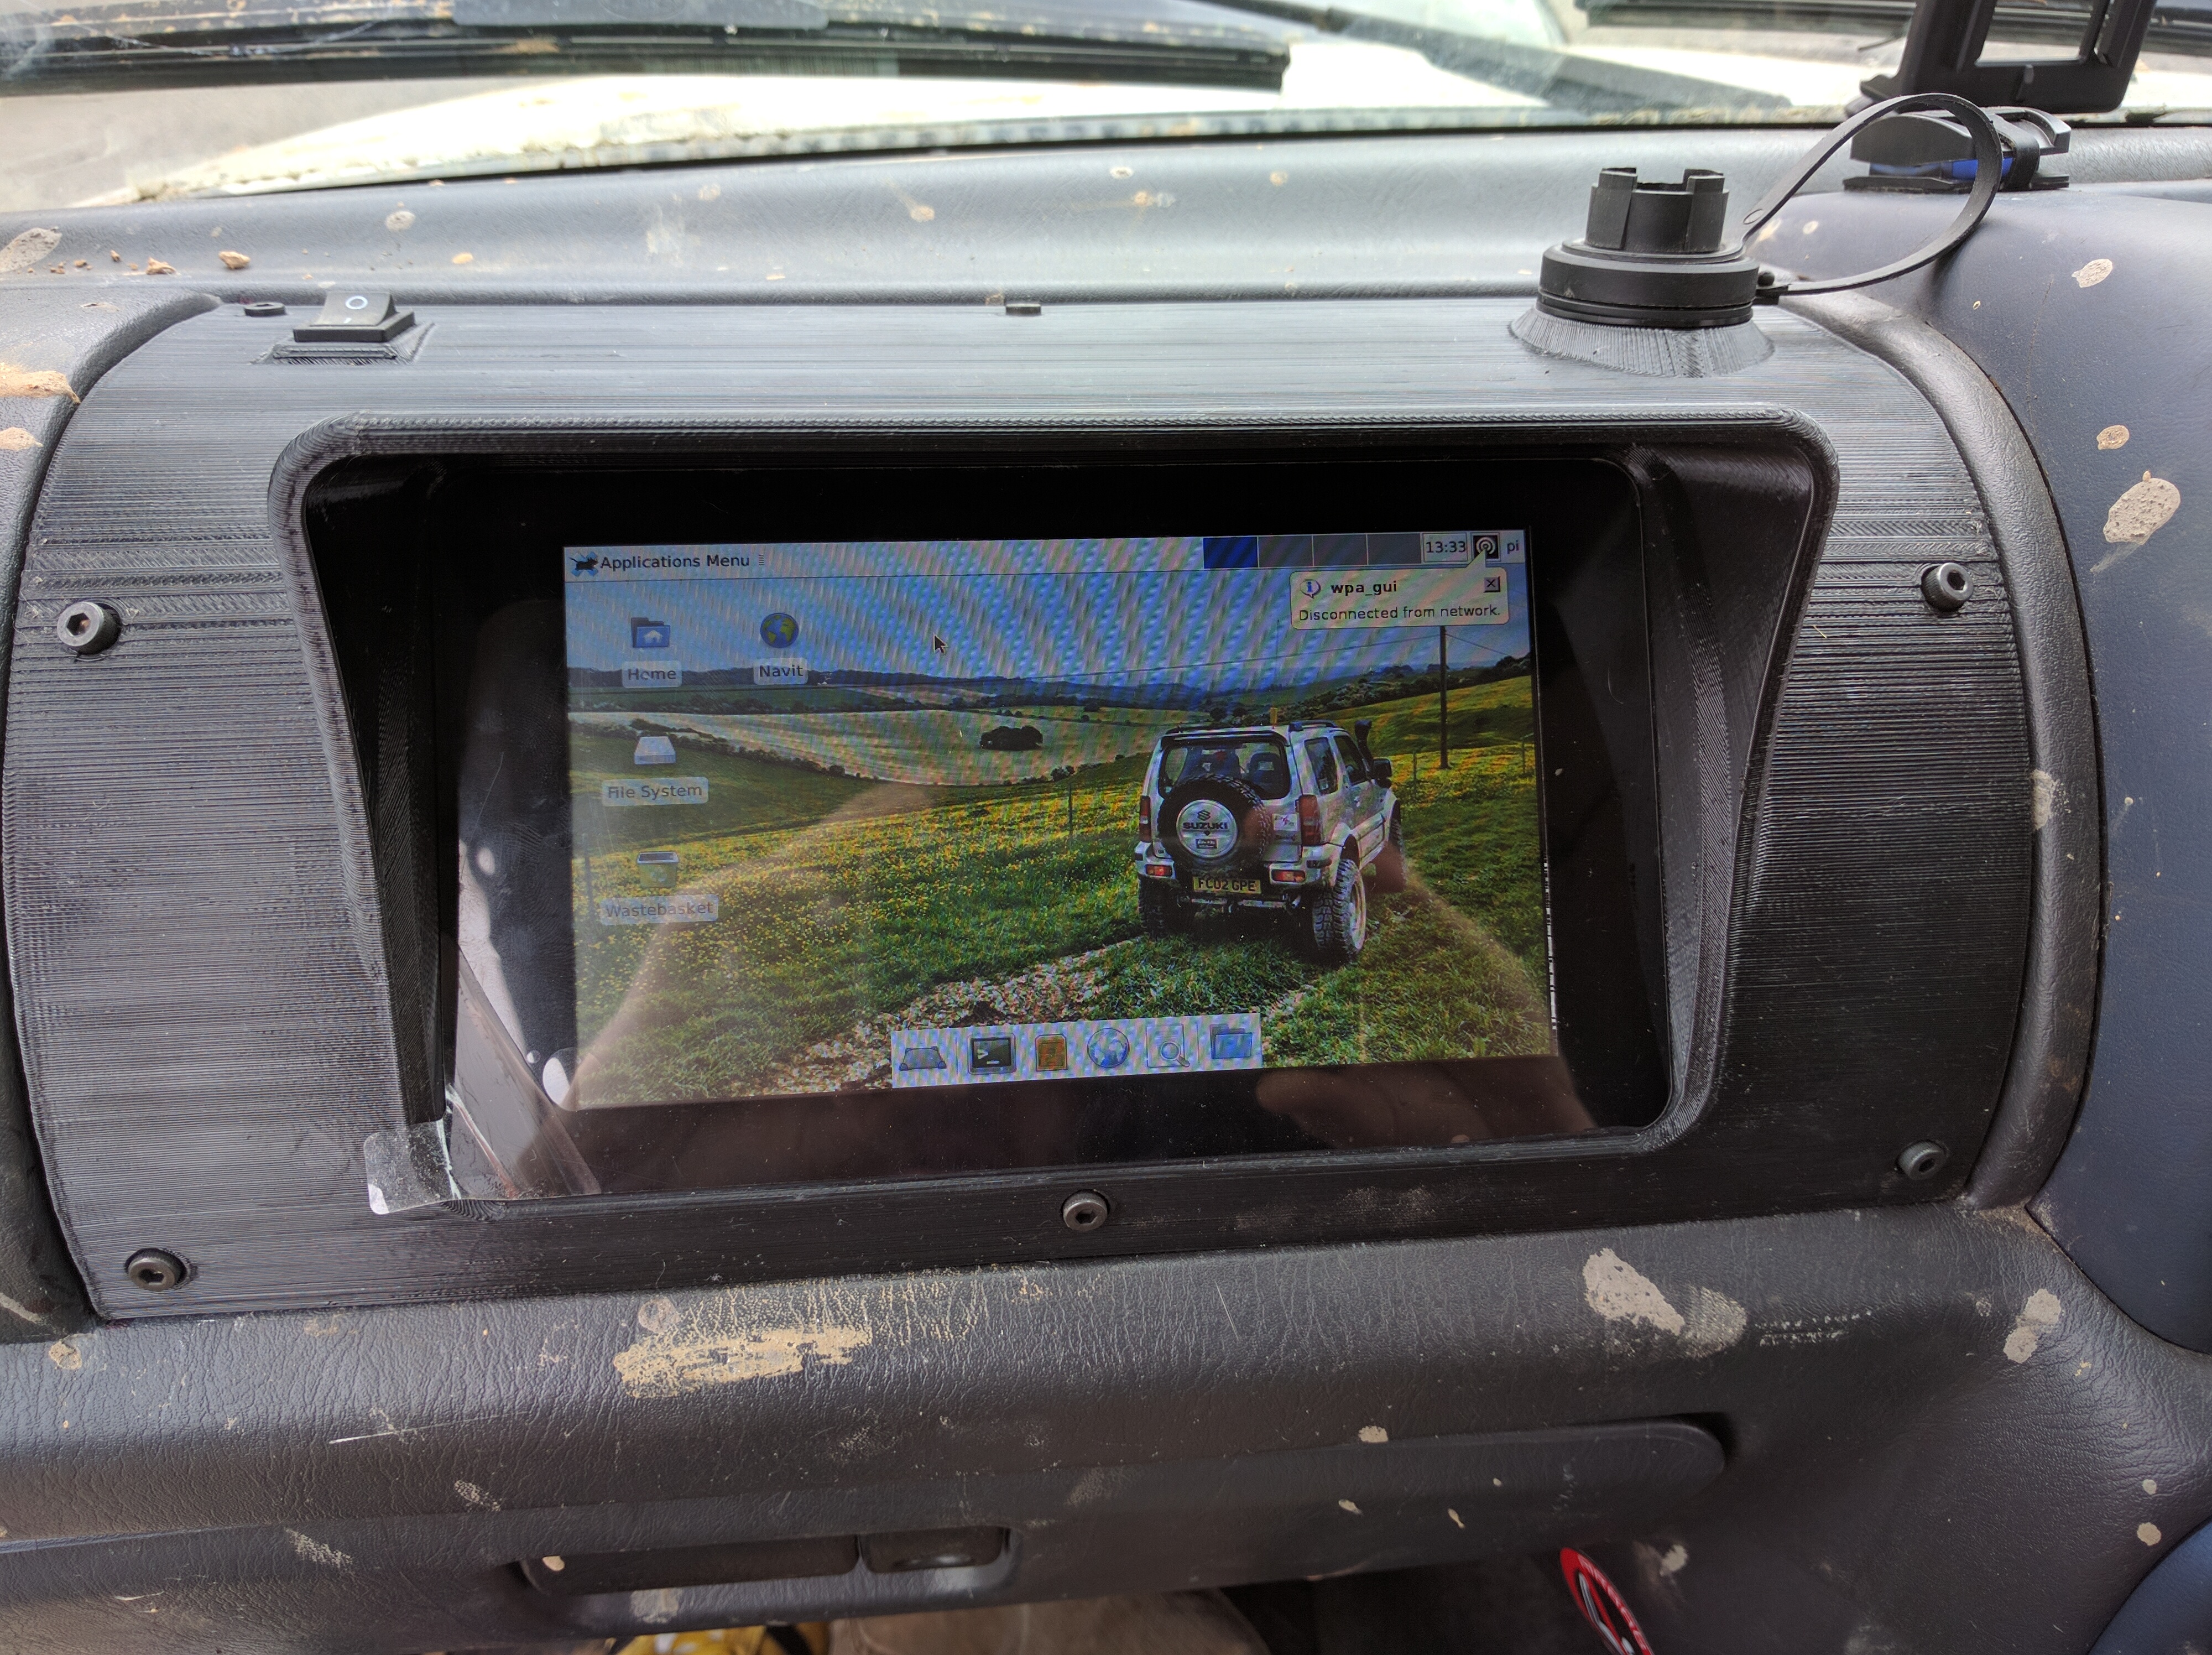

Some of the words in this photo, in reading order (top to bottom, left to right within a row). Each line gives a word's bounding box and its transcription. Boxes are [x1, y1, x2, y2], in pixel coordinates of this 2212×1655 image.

[1426, 540, 1466, 553] 13:33
[1507, 539, 1519, 554] pi
[600, 555, 701, 571] Applications
[707, 554, 750, 567] Menu
[1331, 581, 1397, 596] wpa_gui
[1299, 607, 1398, 621] Disconnected
[1402, 607, 1435, 618] from
[1440, 605, 1500, 617] network.
[628, 668, 677, 681] Home
[759, 664, 804, 678] Navit
[609, 786, 635, 798] File
[641, 784, 702, 800] System
[605, 902, 713, 917] Wastebasket
